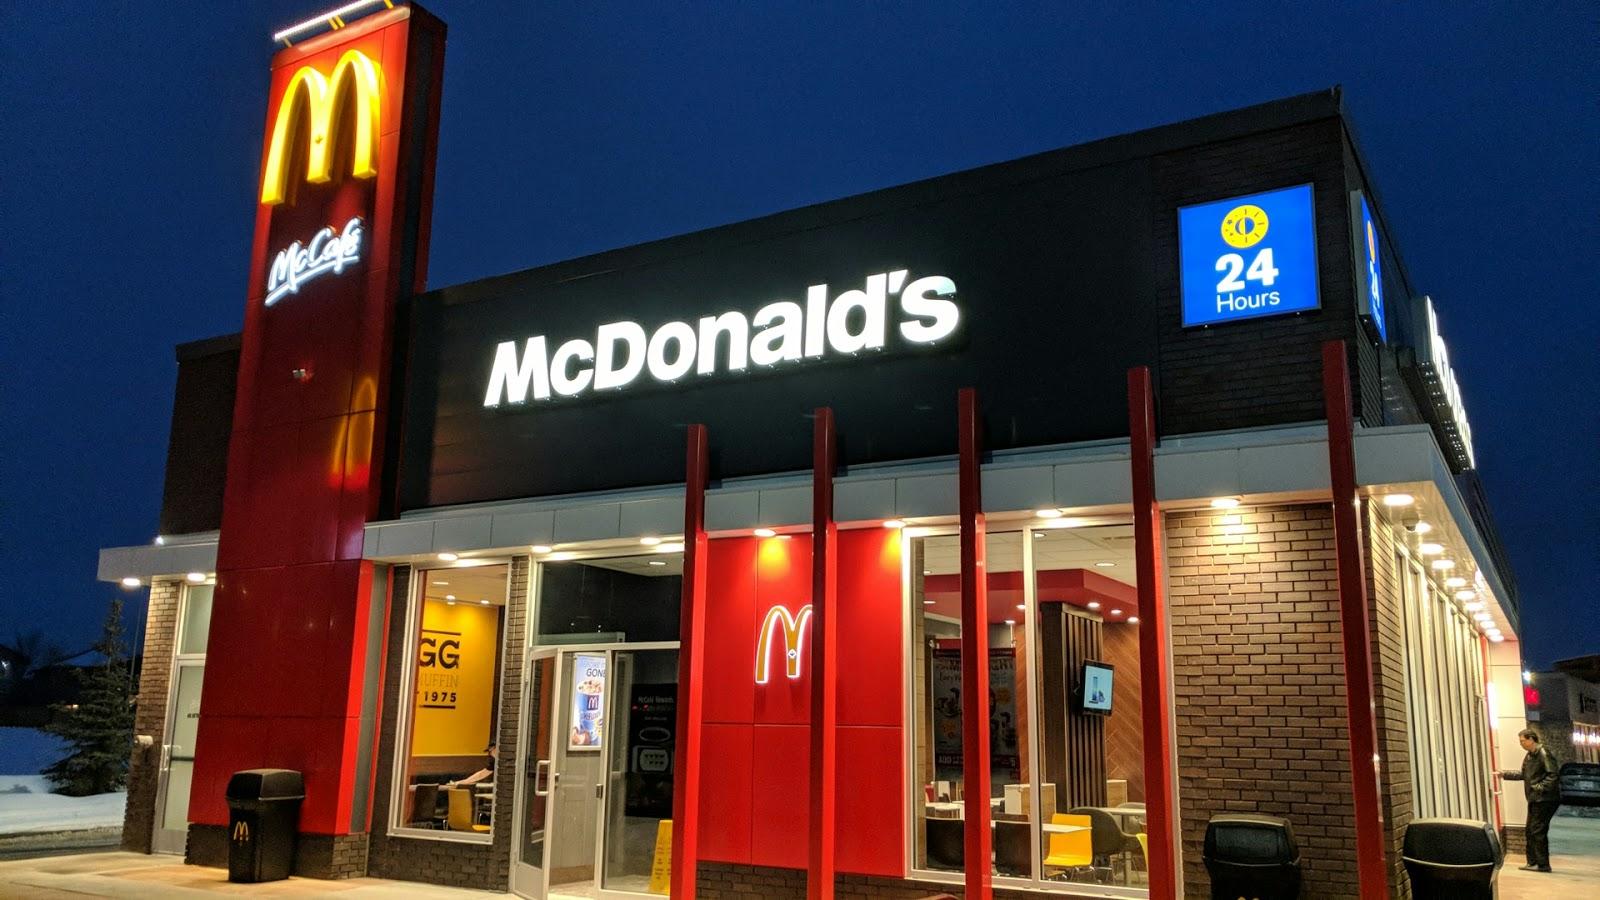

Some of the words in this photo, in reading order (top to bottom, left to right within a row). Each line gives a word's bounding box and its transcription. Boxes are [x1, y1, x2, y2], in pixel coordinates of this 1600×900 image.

[1215, 247, 1279, 293] 24
[1216, 291, 1281, 313] Hours
[483, 269, 959, 407] McDonald's
[420, 673, 458, 688] UFFIN
[425, 691, 456, 702] 1975
